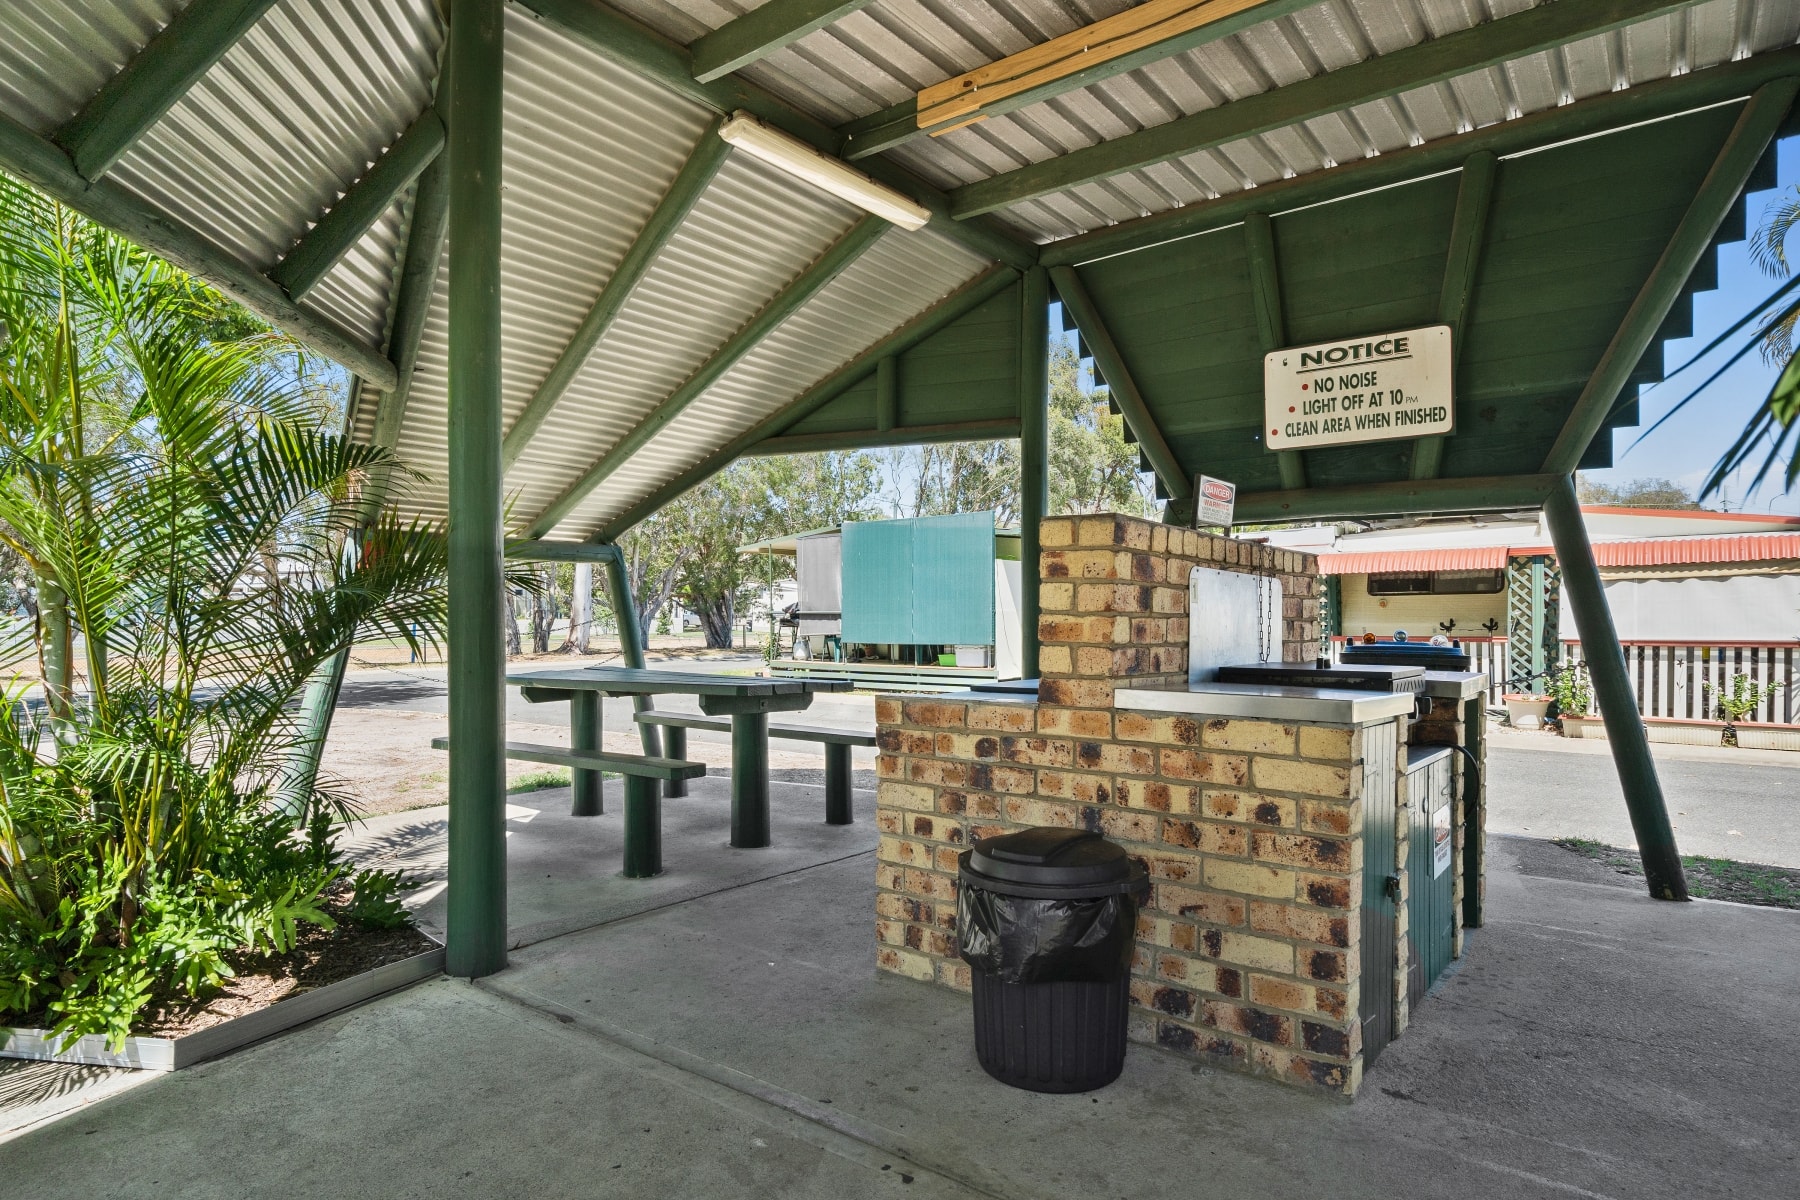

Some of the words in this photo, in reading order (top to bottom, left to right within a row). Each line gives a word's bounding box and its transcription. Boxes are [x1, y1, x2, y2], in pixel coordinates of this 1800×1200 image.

[1301, 337, 1409, 368] NOTICE
[1314, 377, 1334, 393] NO
[1339, 371, 1377, 389] NOISE
[1303, 397, 1337, 416] LIGHT
[1341, 394, 1364, 411] OFF
[1369, 391, 1384, 408] AT
[1390, 389, 1403, 406] 10
[1405, 396, 1418, 404] PM
[1285, 419, 1319, 438] CLEAN
[1322, 416, 1351, 434] AREA
[1355, 412, 1391, 431] WHEN
[1395, 406, 1447, 427] FINISHED
[1205, 485, 1230, 498] DANGER
